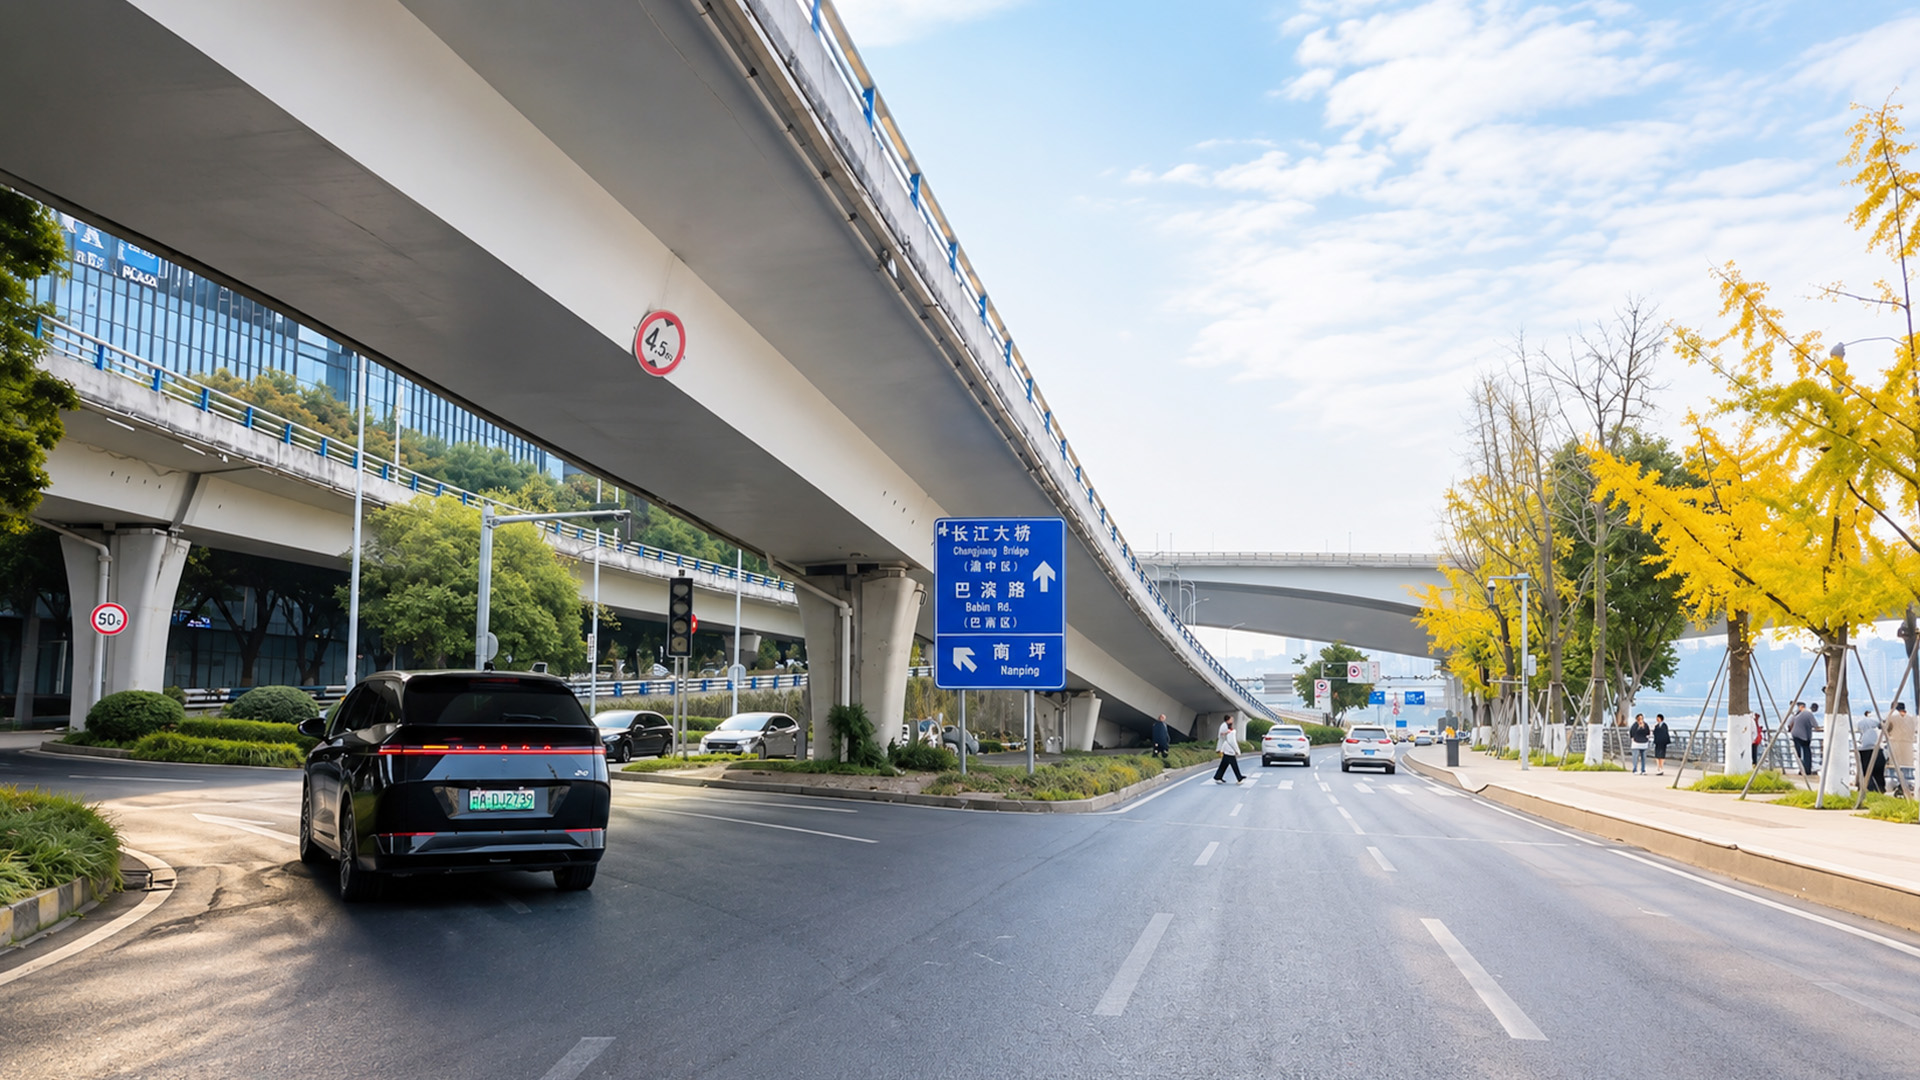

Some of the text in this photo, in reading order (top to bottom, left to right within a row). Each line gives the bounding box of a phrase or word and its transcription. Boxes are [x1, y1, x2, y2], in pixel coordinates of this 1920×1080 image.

[951, 524, 1031, 542] 长江大桥
[953, 546, 997, 557] Changjiang
[966, 602, 1012, 612] Babin Rd.
[992, 642, 1046, 661] 南坪
[1001, 664, 1040, 678] Nanping
